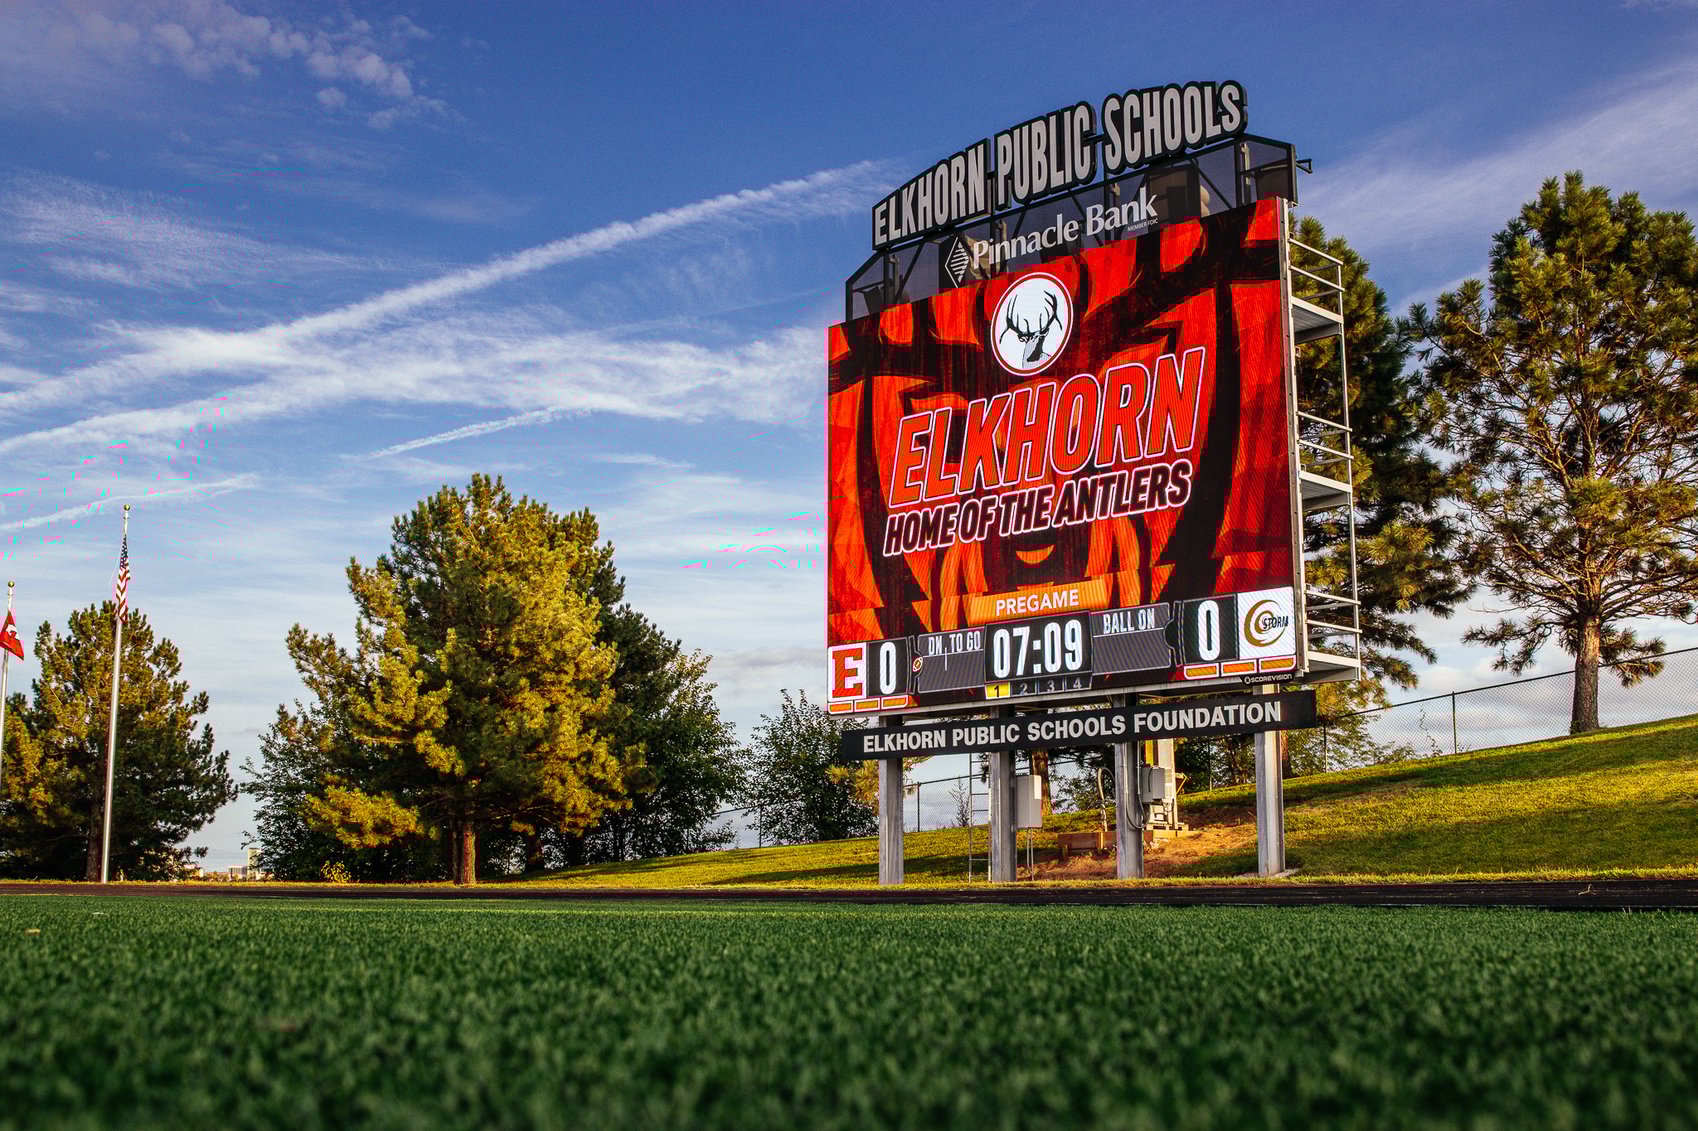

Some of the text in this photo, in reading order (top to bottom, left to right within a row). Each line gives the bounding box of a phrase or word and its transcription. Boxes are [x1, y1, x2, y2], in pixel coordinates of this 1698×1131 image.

[874, 84, 1241, 246] ELKHORN PUBLIC SCHOOLS
[973, 183, 1158, 269] Pinnacle Bank
[1127, 220, 1147, 232] MEMBER
[889, 347, 1205, 508] ELKHORN
[883, 458, 1192, 557] HOME OF THE ANTLERS
[996, 589, 1080, 616] PREGAME
[1103, 608, 1155, 634] BALL ON
[1197, 599, 1220, 661] 0
[1262, 615, 1289, 630] STORM
[949, 632, 963, 654] TO
[966, 630, 981, 651] GO
[993, 619, 1083, 679] 07:09
[831, 647, 863, 697] E
[879, 641, 897, 695] 0
[1047, 679, 1055, 692] 3
[1073, 677, 1082, 689] 4
[993, 685, 1000, 698] 1
[1019, 682, 1029, 695] 2
[863, 701, 1281, 753] ELKHORN PUBLIC SCHOOLS FOUNDATION
